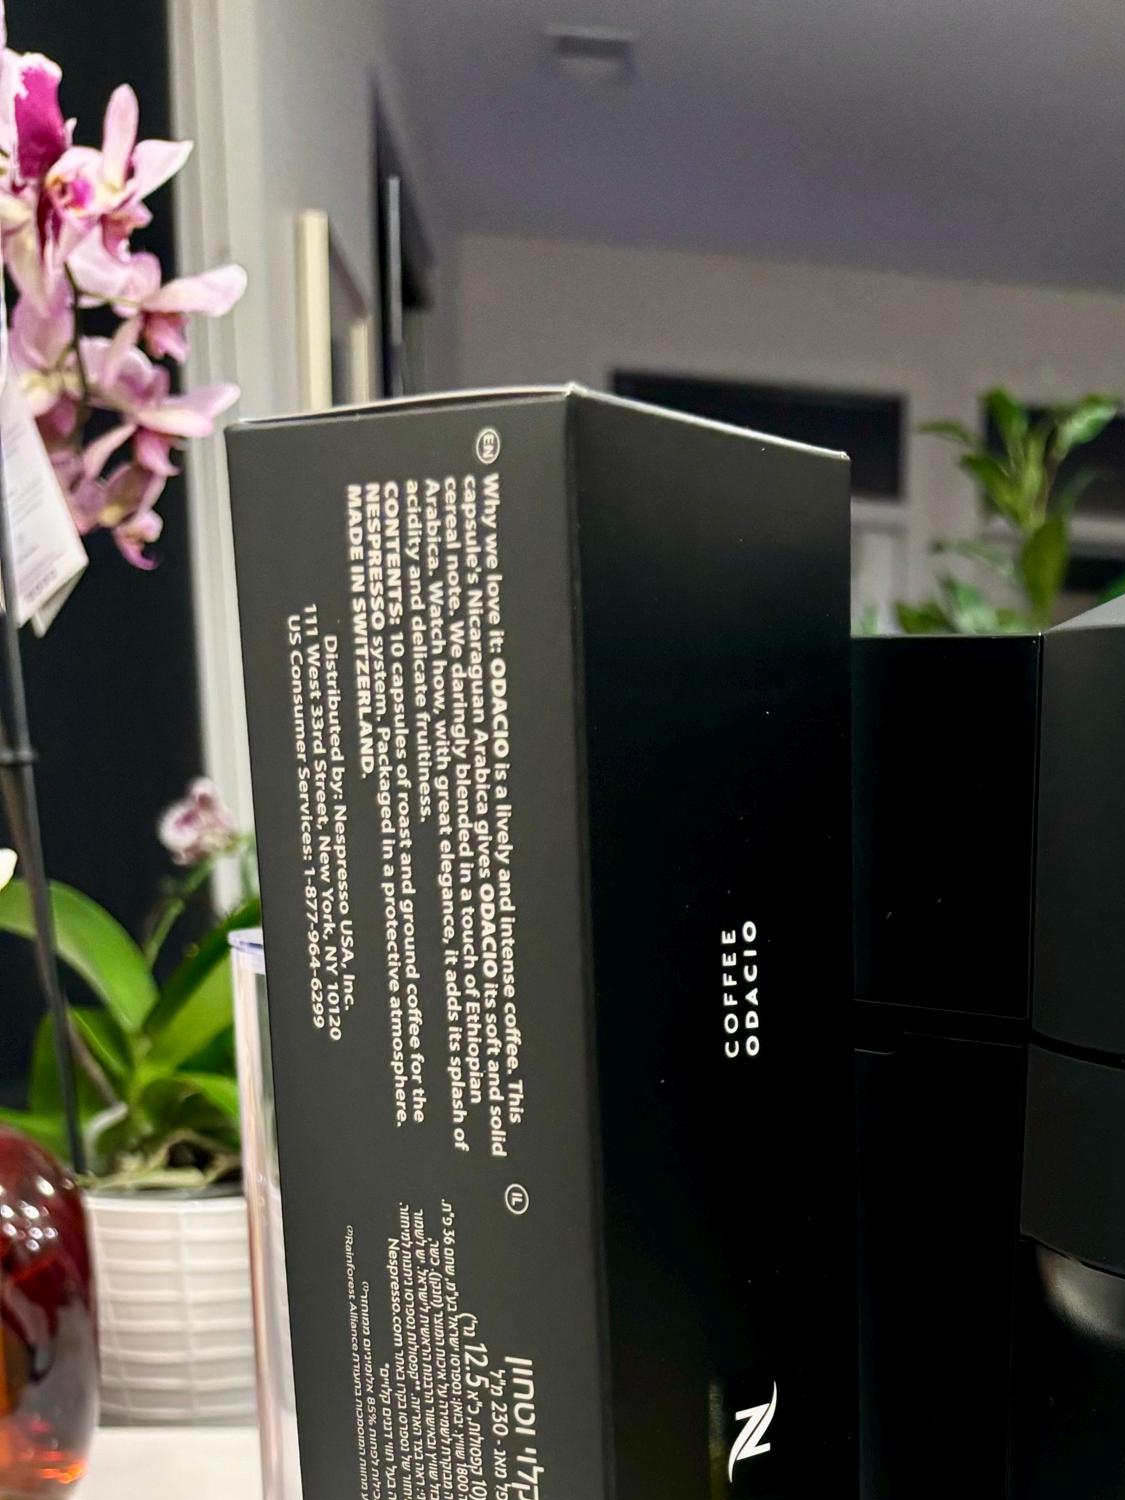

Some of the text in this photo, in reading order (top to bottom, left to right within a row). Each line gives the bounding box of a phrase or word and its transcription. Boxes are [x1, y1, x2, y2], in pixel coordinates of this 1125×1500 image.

[286, 614, 325, 1028] US Consumer Services: 1-877-964-6299
[303, 603, 342, 1041] 111 West 33rd Street, New York, NY 10120
[323, 634, 355, 1011] Distributed by: Nespresso USA, Inc.
[346, 483, 375, 778] MADE IN SWITZERLAND.
[364, 482, 408, 1127] NESPRESSO system. Packaged in a protective atmosphere.
[382, 480, 427, 1123] CONTENTS: 10 capsules of roast and ground coffee for the
[404, 478, 432, 822] acidity and delicate fruitiness.
[424, 477, 469, 1152] Arabica. Watch how, with great elegance, it adds its splash of
[443, 475, 484, 1104] cereal note. We daringly blended in a touch of Ethiopian
[460, 473, 507, 1157] capsule's Nicaraguan Arabica gives ODACIO its soft and solid
[480, 472, 524, 1123] Why we love it: ODACIO is a lively and intense coffee. This
[720, 929, 740, 1059] COFFEE
[741, 920, 760, 1057] ODACIO
[385, 1237, 403, 1347] Nespresso.com
[463, 1342, 490, 1388] 12.5
[490, 1400, 509, 1436] 230
